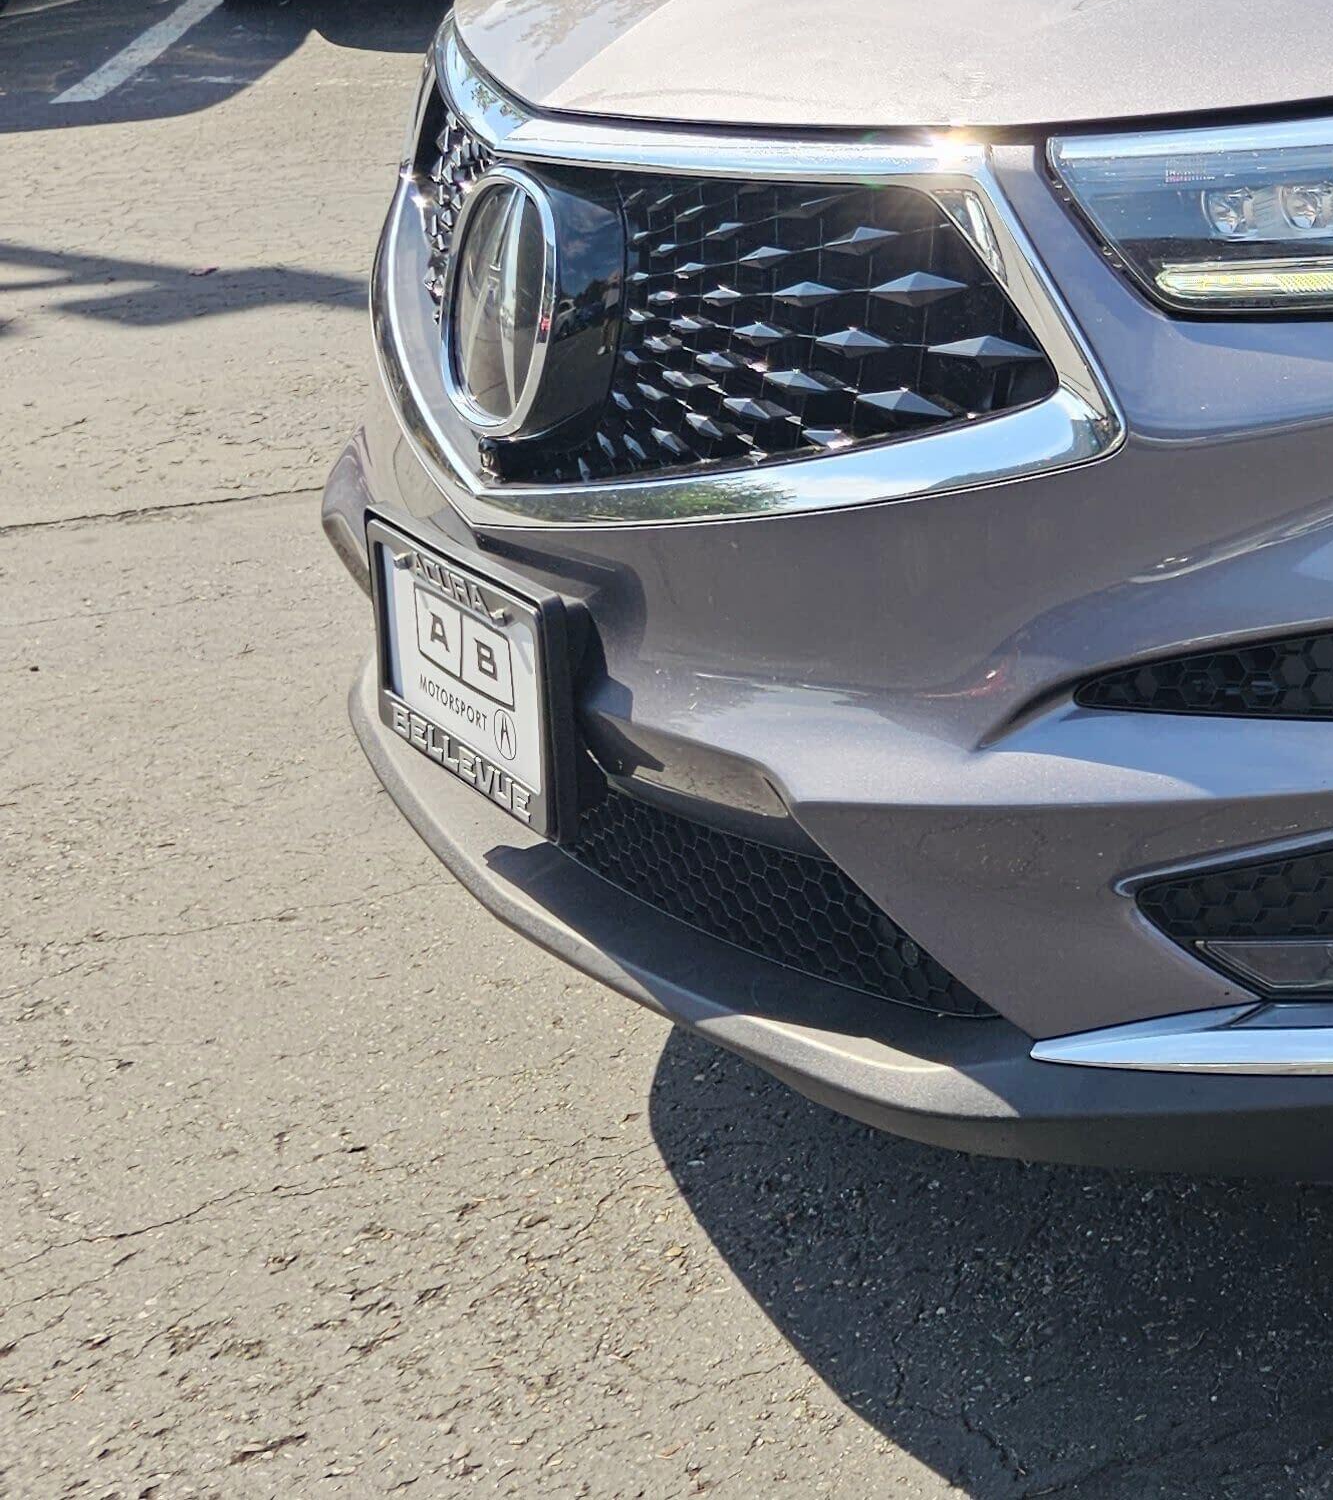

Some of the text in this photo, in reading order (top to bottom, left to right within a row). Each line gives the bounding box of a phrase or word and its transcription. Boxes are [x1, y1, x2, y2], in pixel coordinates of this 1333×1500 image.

[413, 550, 491, 615] ACURA
[430, 611, 498, 681] A B
[419, 673, 488, 732] MOTORSPORT
[391, 702, 531, 823] BELLEVUE
